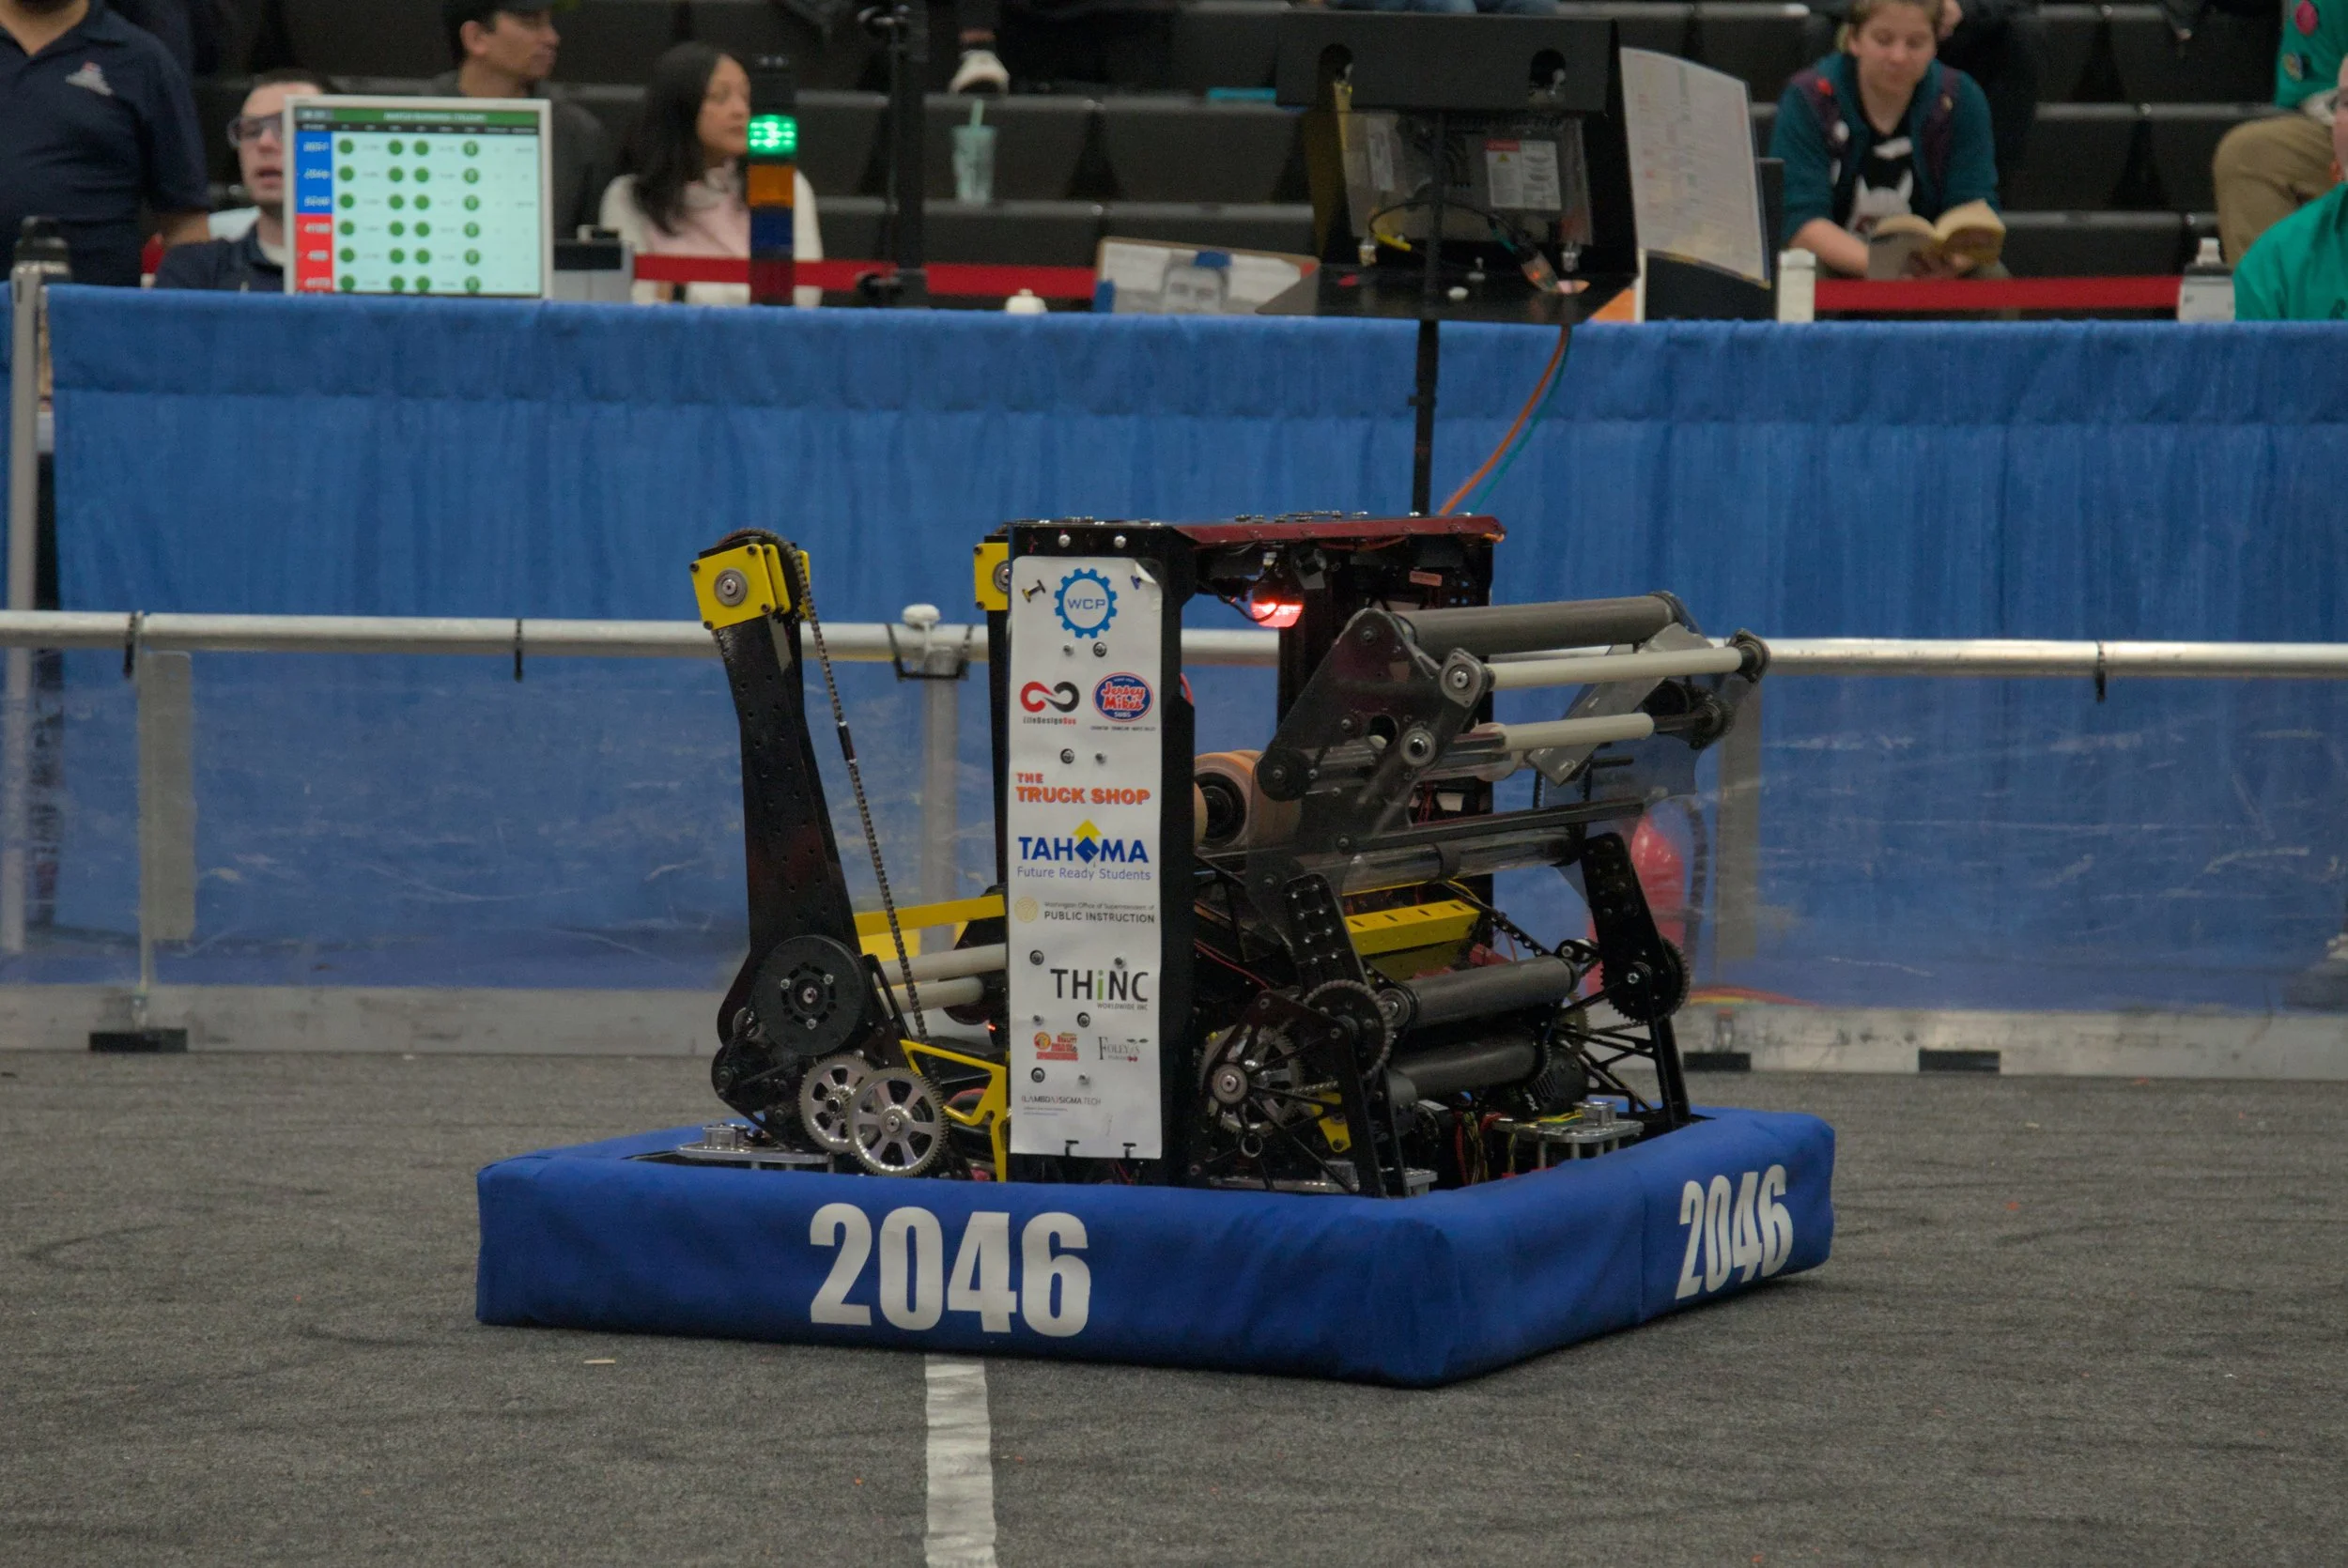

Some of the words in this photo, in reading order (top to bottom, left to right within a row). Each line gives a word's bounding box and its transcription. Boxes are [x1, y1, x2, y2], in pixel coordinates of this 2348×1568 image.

[1067, 598, 1106, 610] WCP
[1102, 682, 1146, 700] Jersey
[1016, 772, 1044, 784] THE
[1015, 786, 1087, 805] TRUCK
[1090, 788, 1151, 806] SHOP
[1017, 867, 1055, 878] Future
[1059, 868, 1095, 881] Ready
[1099, 869, 1151, 881] Students
[1044, 911, 1082, 921] PUBLIC
[1086, 913, 1155, 924] INSTRUCTION
[1083, 1096, 1101, 1106] TECH
[1676, 1163, 1793, 1299] 2046
[810, 1202, 1091, 1337] 2046
